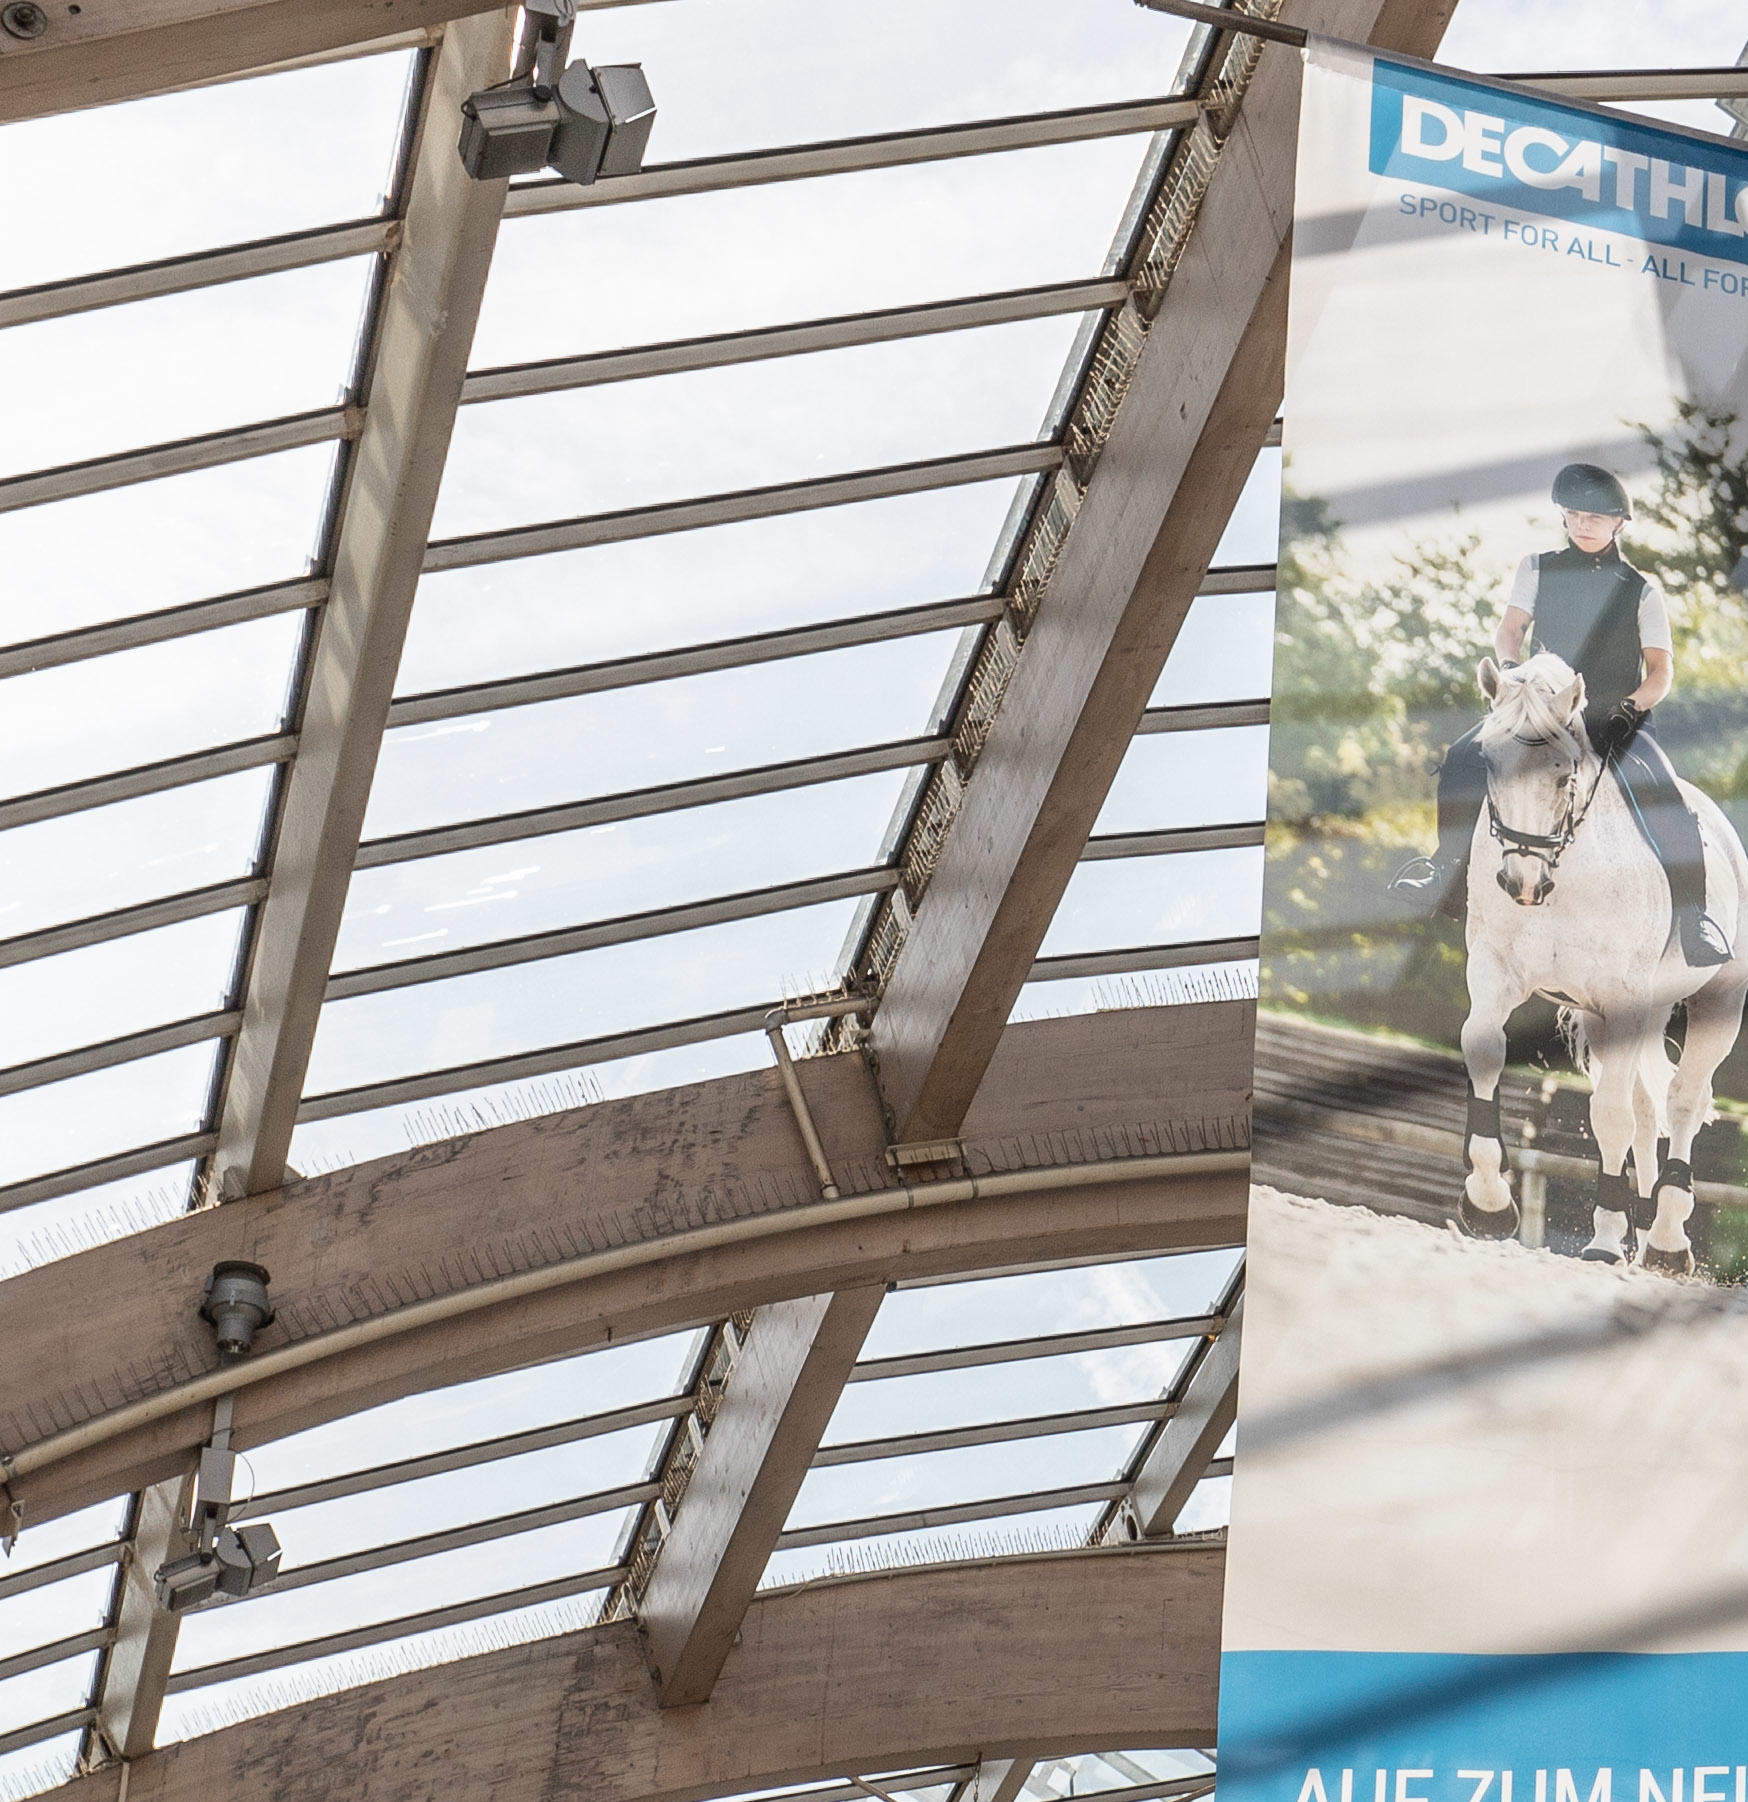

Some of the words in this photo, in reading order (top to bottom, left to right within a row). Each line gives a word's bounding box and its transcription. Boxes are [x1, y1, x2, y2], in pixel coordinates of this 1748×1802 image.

[1399, 194, 1496, 235] SPORT
[1504, 219, 1559, 252] FOR
[1566, 237, 1622, 267] ALL
[1641, 254, 1695, 286] ALL
